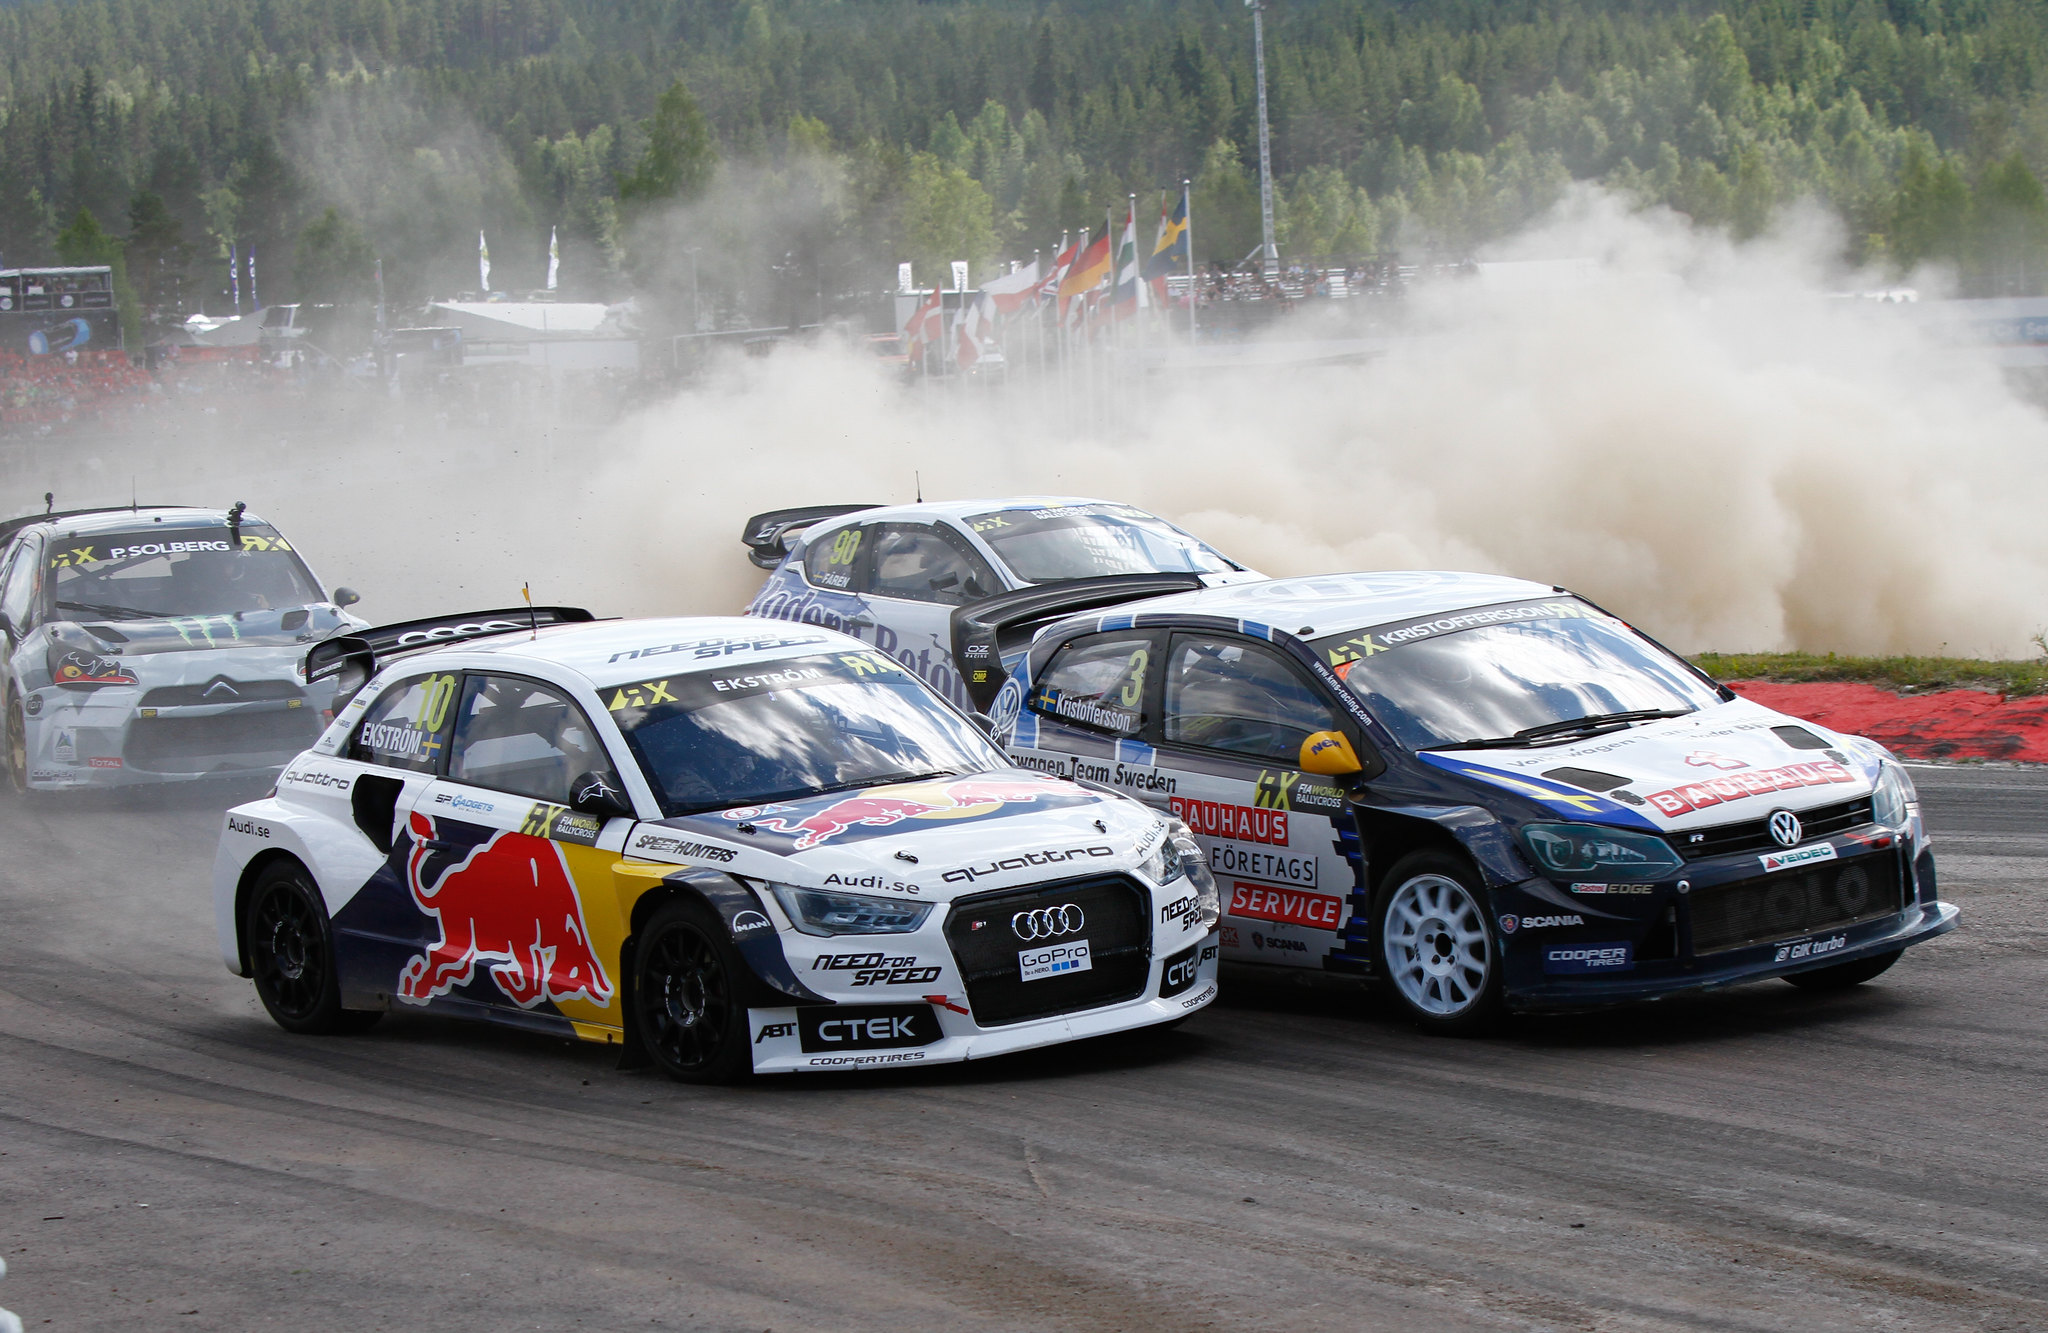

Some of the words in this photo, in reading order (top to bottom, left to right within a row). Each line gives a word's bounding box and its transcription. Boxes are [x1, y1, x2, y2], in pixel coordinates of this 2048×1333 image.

[110, 541, 231, 559] P.SOLBERG
[830, 530, 862, 565] 90
[1379, 606, 1553, 645] KRISTOFFERSSON
[608, 637, 726, 663] NEED
[692, 634, 829, 660] SPEED
[712, 668, 823, 692] EKSTRÖM
[1121, 649, 1149, 707] 3
[415, 673, 455, 733] 10
[1313, 661, 1373, 726] www.kms-racing.com
[1056, 693, 1131, 732] Kristoffersson
[361, 722, 423, 755] EKSTRÖM
[90, 758, 120, 767] TOTAL
[286, 771, 350, 790] quattro
[1070, 756, 1109, 783] Team
[1114, 764, 1177, 794] Sweden
[1652, 763, 1846, 813] BAUHAUS
[1296, 794, 1342, 808] RALLYCROSS
[229, 818, 270, 838] Audi.se
[556, 824, 596, 839] RALLYCROSS
[1172, 802, 1286, 840] BAUHAUS
[636, 834, 737, 863] SPEEDHUNTERS
[1135, 820, 1165, 858] Audi.se
[942, 846, 1114, 883] quattro
[1212, 844, 1313, 882] FÖRETAGS
[1773, 847, 1832, 864] VEIDEC
[824, 873, 920, 895] Audi.se
[1608, 883, 1655, 894] EDGE
[1161, 896, 1189, 924] NEED
[1233, 887, 1338, 923] SERVICE
[736, 920, 769, 932] MAN
[1522, 915, 1584, 928] SCANIA
[1198, 945, 1219, 967] ABT
[1266, 937, 1308, 953] SCANIA
[1548, 948, 1627, 961] COOPER
[1812, 935, 1846, 954] turbo
[812, 953, 885, 970] NEED
[880, 956, 917, 968] FOR
[1022, 946, 1088, 967] GoPro
[1585, 957, 1626, 967] TIRES
[850, 966, 943, 986] SPEED
[1168, 955, 1196, 986] CTE
[755, 1022, 798, 1044] ABT
[818, 1016, 916, 1041] CTEK
[810, 1051, 926, 1066] COOPERTIRES
